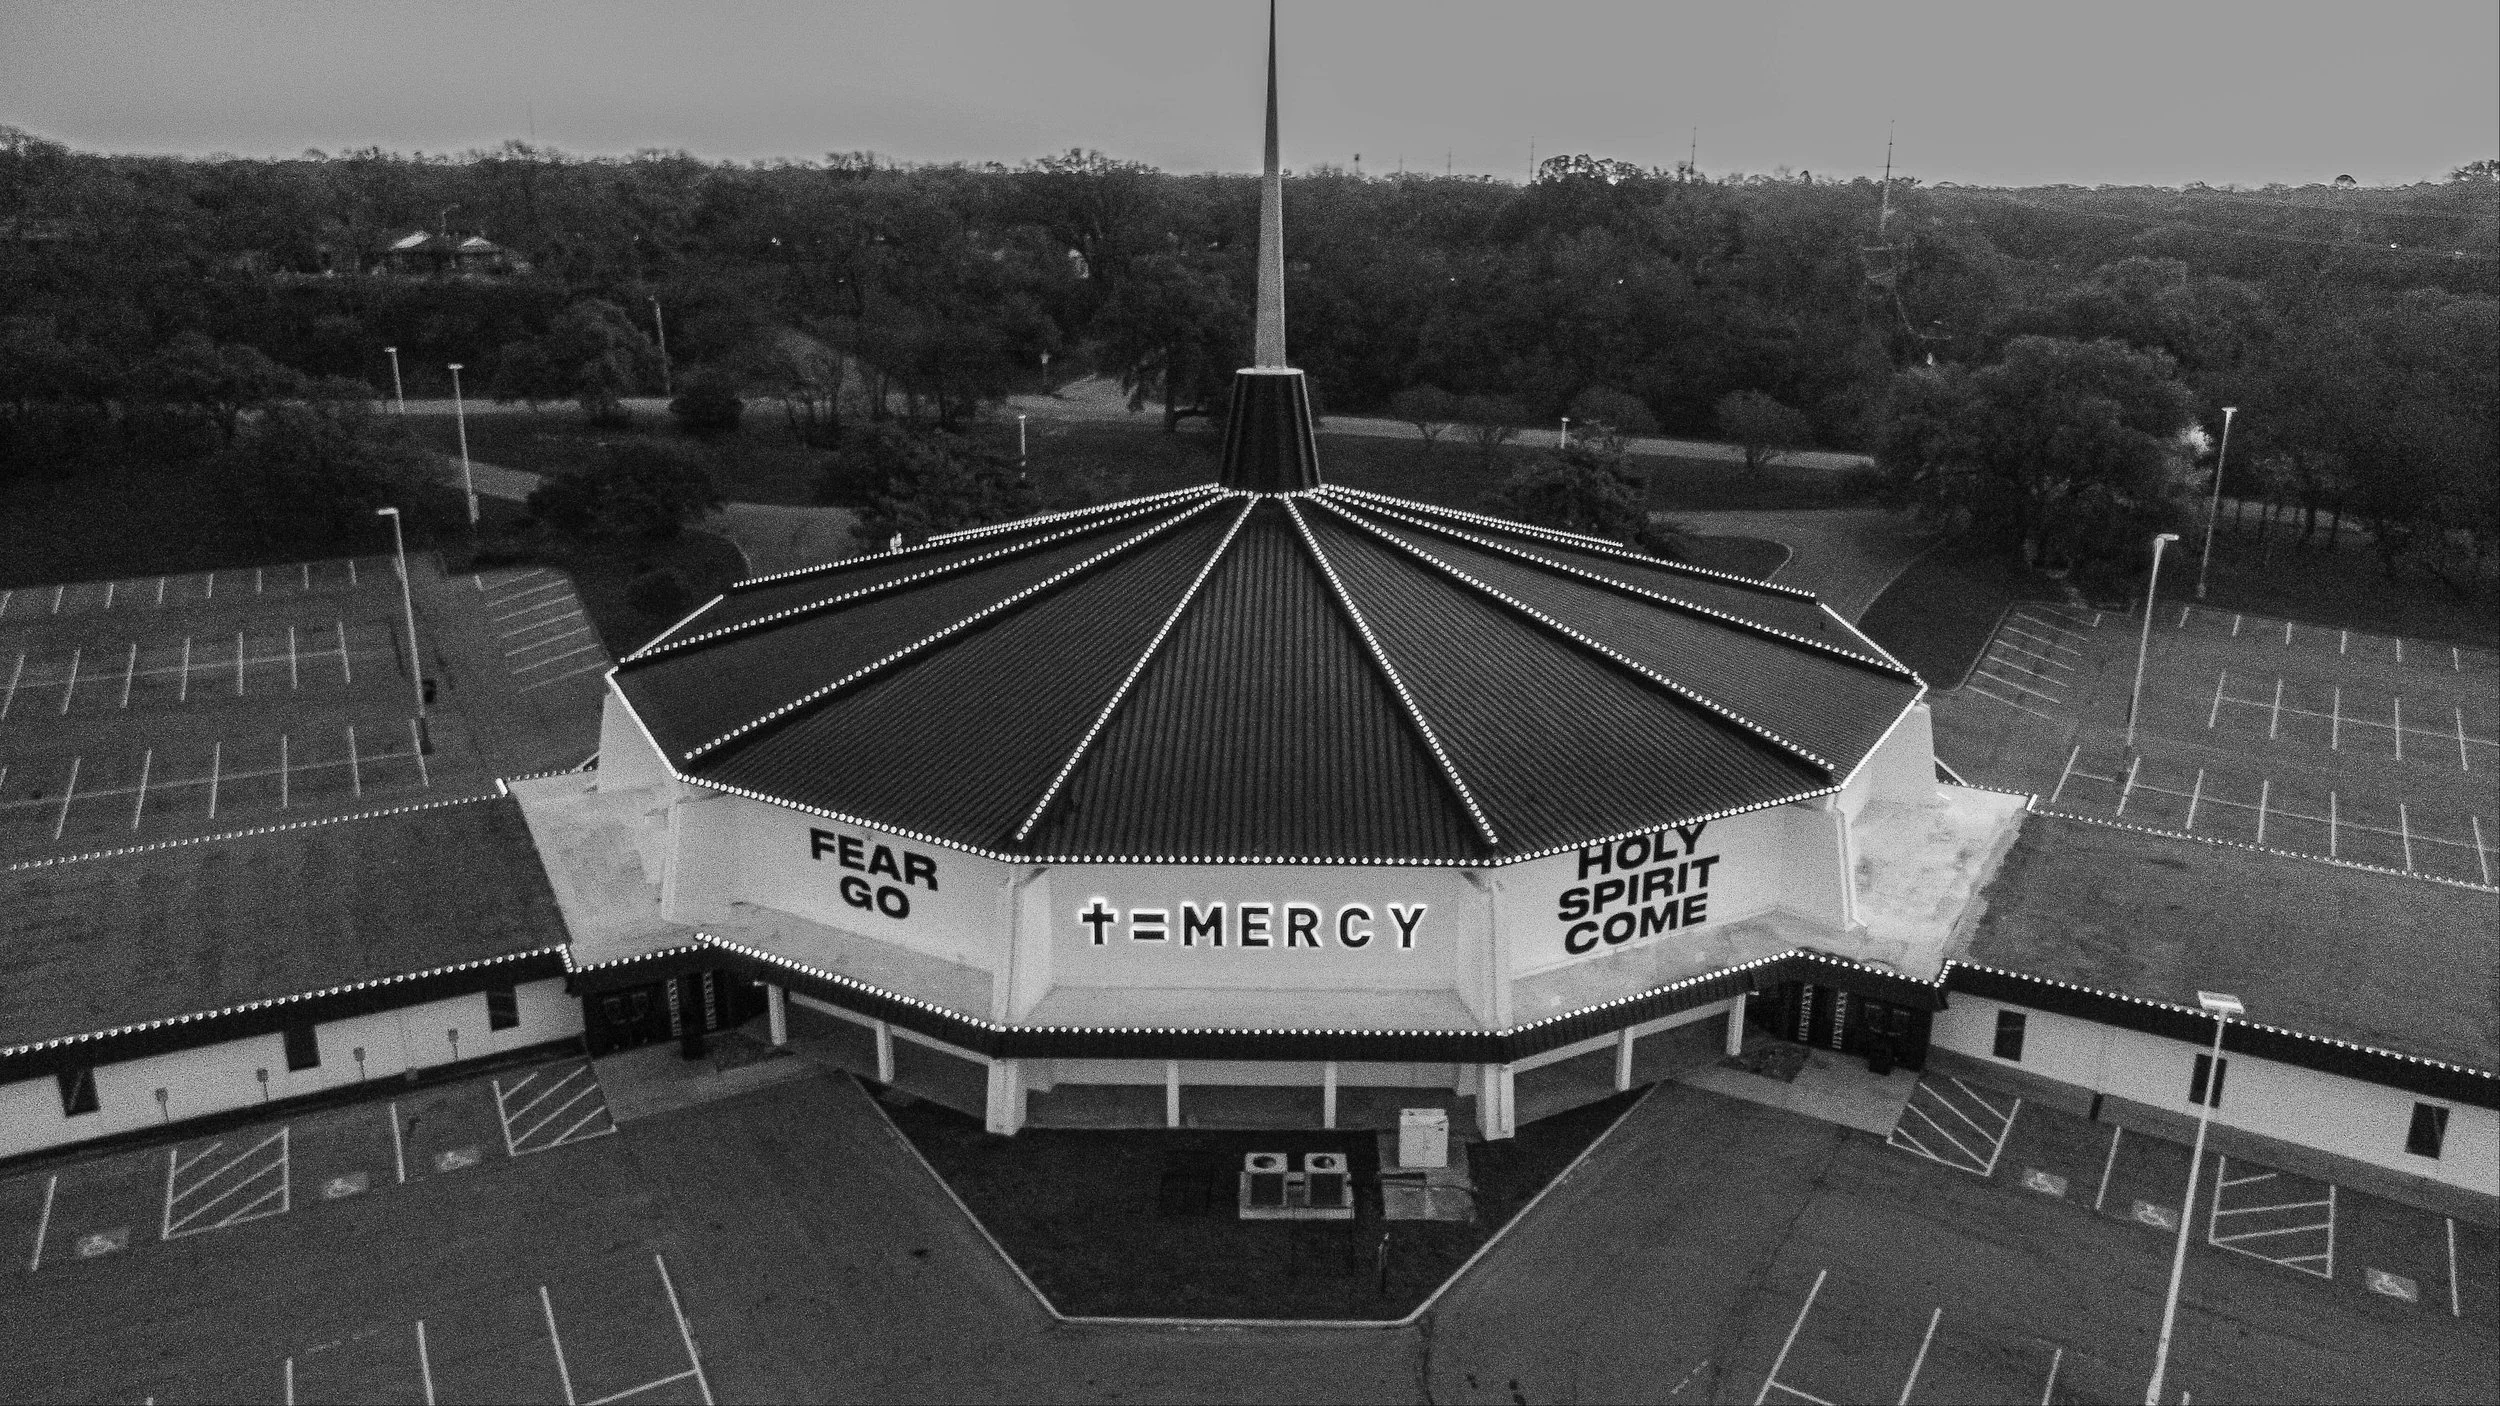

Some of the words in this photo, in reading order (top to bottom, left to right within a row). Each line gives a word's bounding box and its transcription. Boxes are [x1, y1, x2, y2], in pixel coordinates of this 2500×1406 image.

[810, 827, 938, 891] FEAR
[1578, 821, 1708, 880] HOLY
[840, 875, 910, 919] GO
[1558, 854, 1720, 922] SPIRIT
[1183, 905, 1426, 948] MERCY
[1564, 892, 1708, 955] COME
